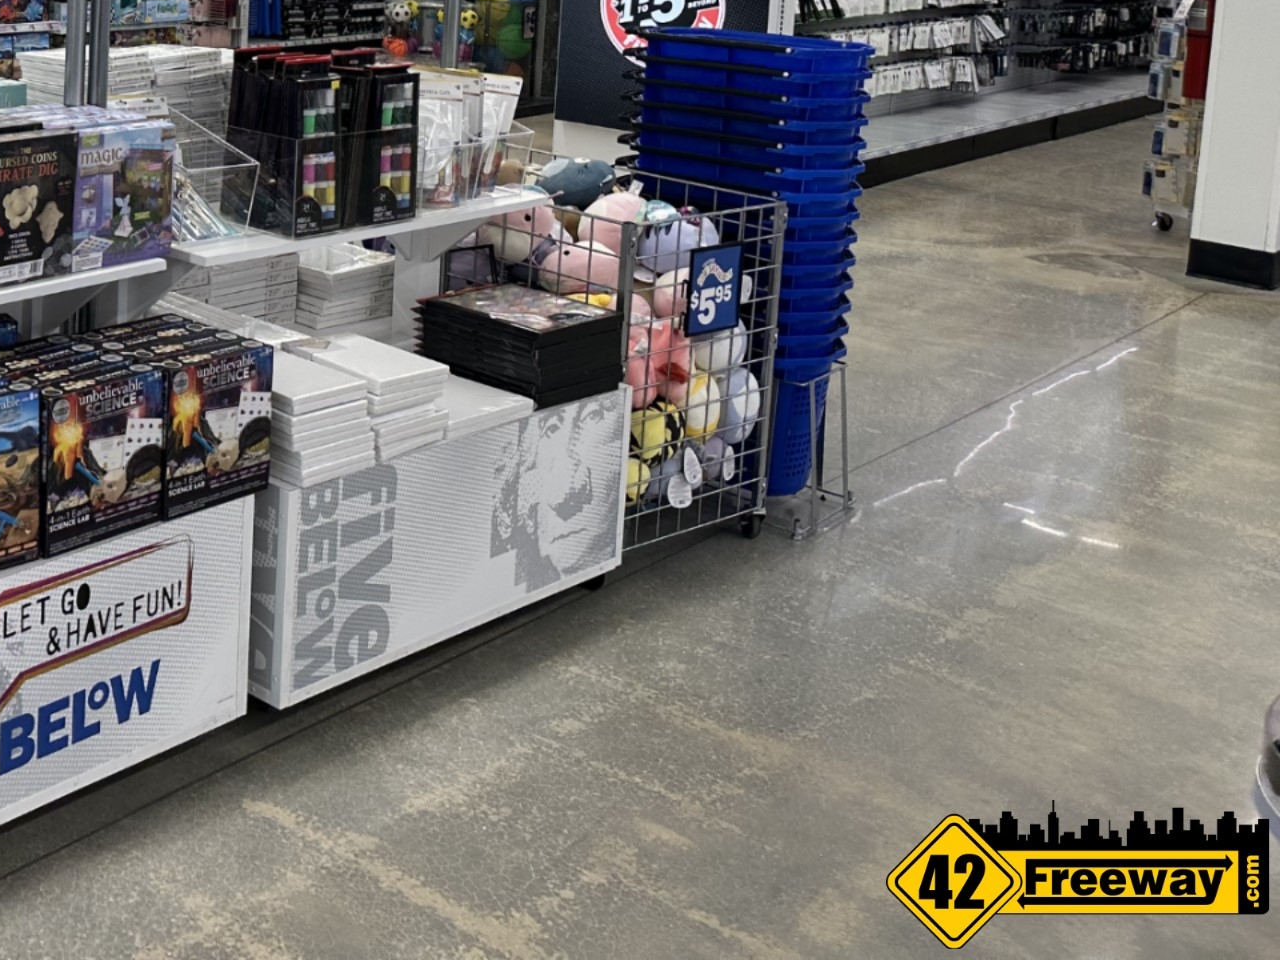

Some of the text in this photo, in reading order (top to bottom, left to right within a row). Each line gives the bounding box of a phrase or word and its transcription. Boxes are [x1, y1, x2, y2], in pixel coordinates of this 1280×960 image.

[31, 152, 58, 165] COINS
[38, 162, 58, 176] DIG
[196, 354, 257, 378] unbelievable
[203, 368, 250, 390] SCIENCE
[29, 392, 39, 401] 8+
[79, 379, 144, 405] unbelievable
[86, 394, 137, 416] SCIENCE
[169, 481, 206, 498] SCIENCE LAB
[49, 515, 90, 533] SCIENCE LAB
[2, 582, 91, 639] LET GO
[131, 581, 183, 626] FUN!
